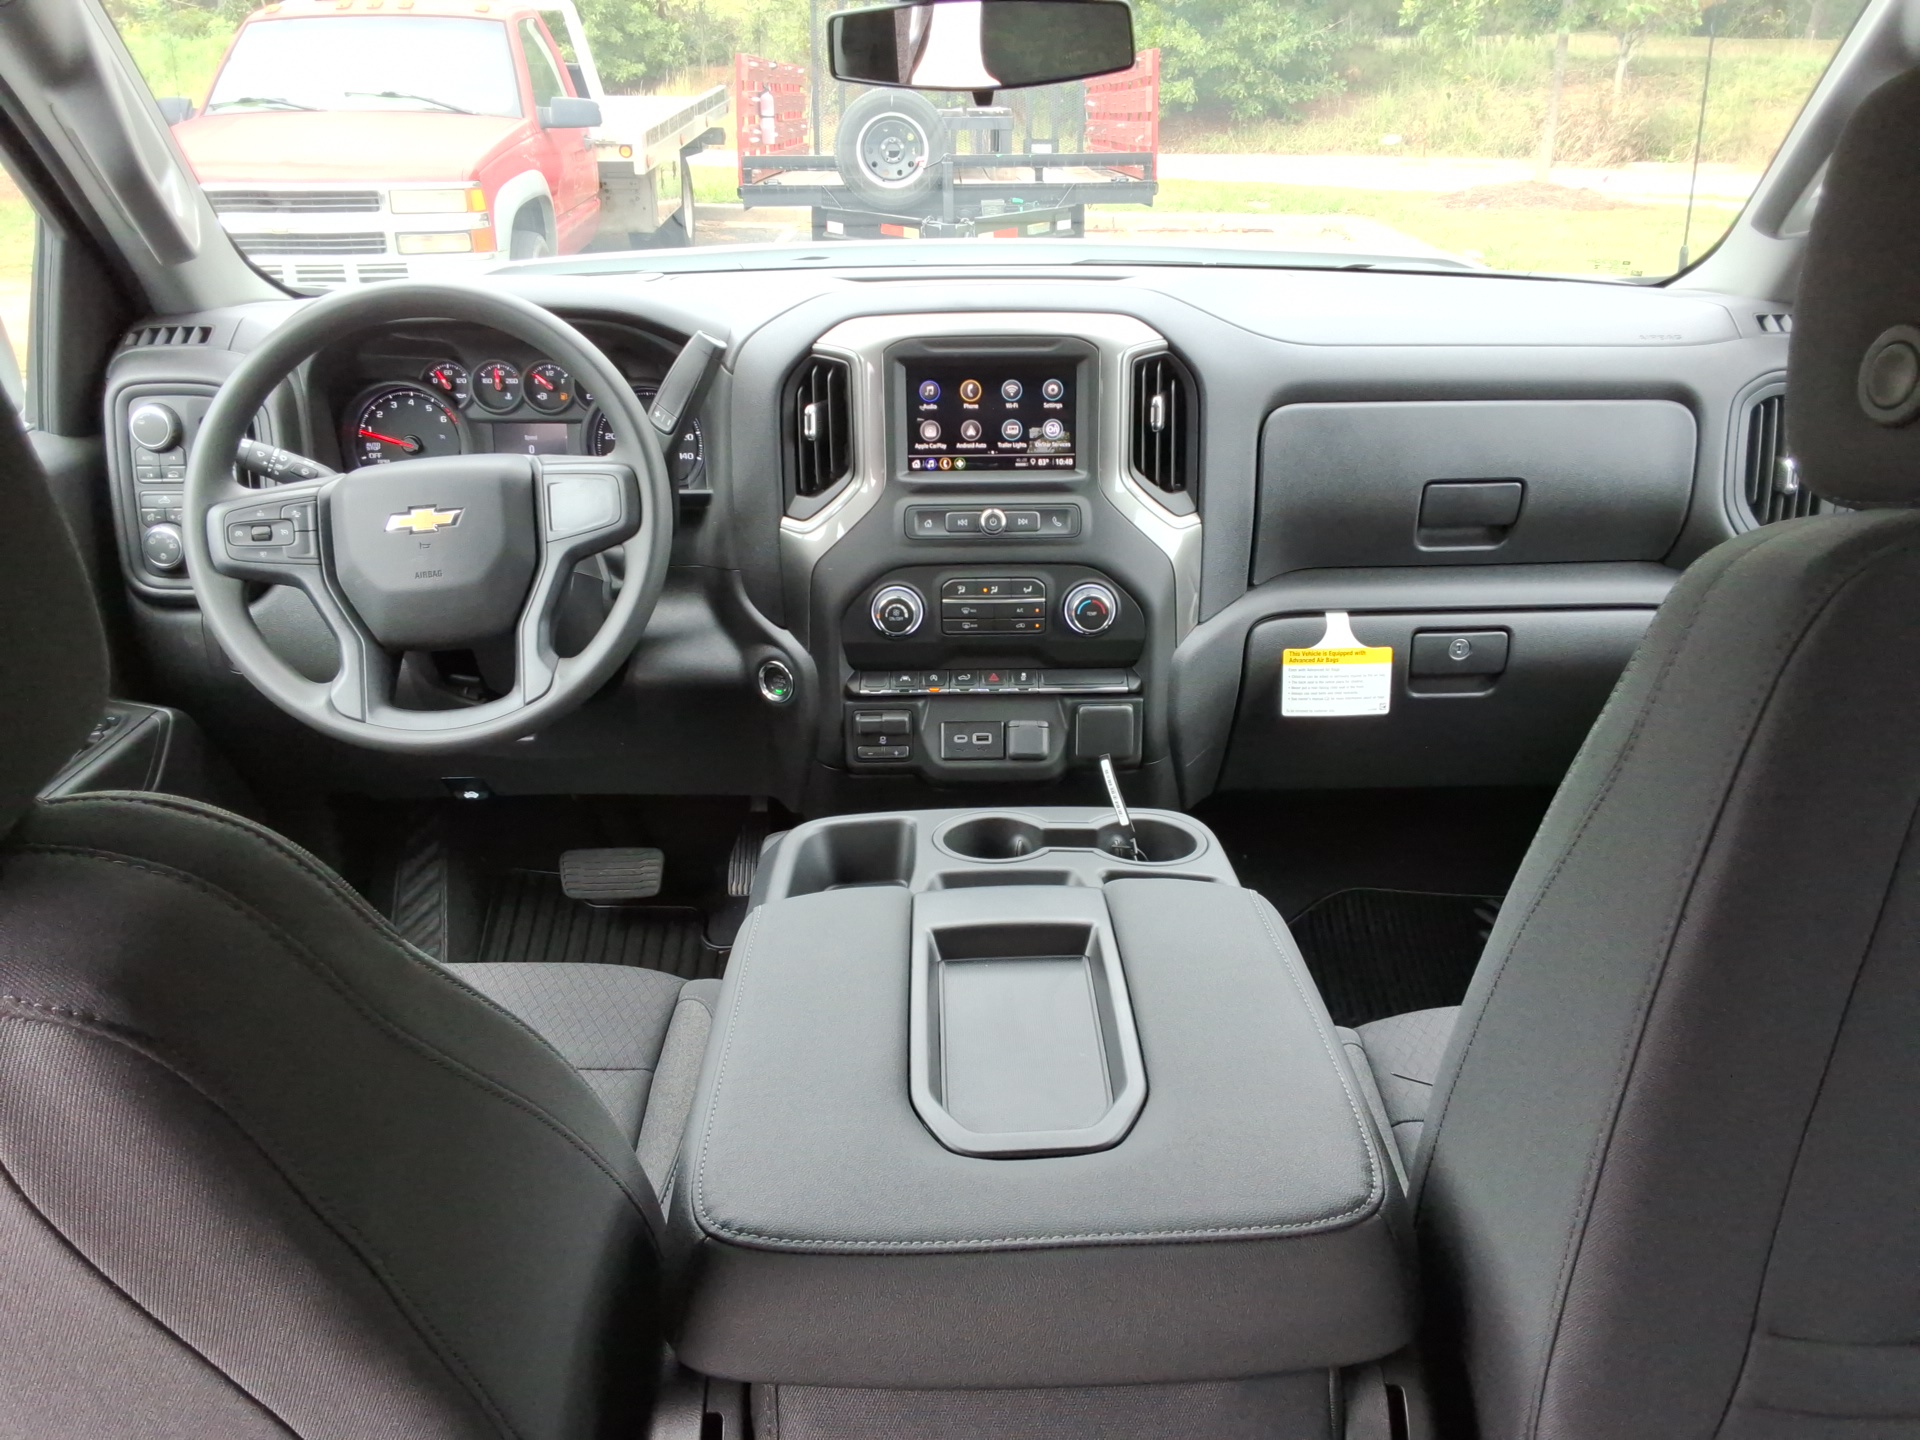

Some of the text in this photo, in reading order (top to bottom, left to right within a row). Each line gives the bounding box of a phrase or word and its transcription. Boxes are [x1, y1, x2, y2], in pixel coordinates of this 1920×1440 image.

[390, 401, 398, 409] 3
[376, 410, 384, 418] 2
[528, 444, 535, 454] 0
[415, 570, 442, 579] AIRBAG
